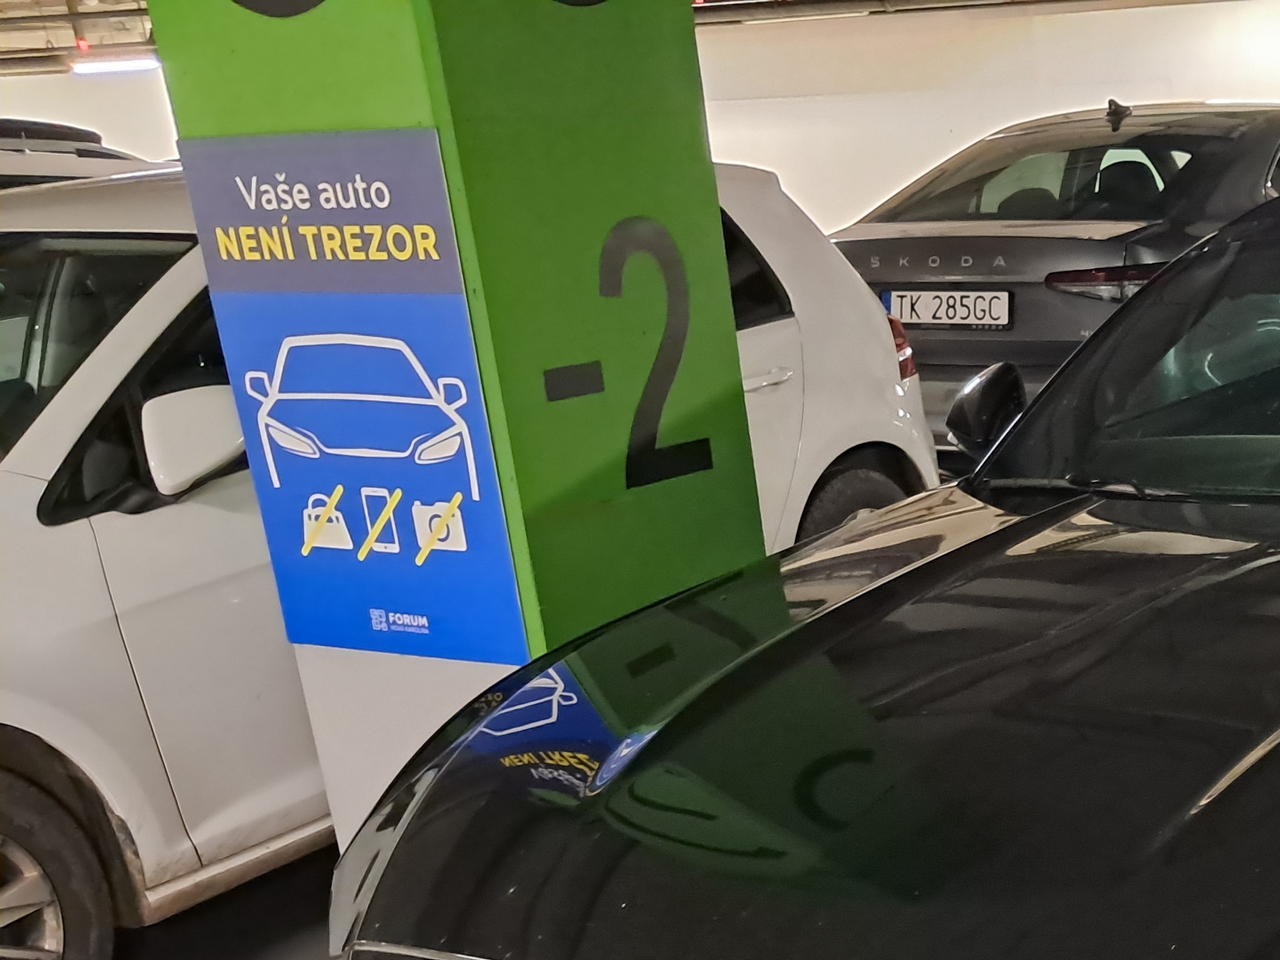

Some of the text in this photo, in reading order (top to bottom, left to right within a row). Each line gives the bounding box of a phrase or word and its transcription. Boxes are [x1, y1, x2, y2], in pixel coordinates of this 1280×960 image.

[234, 172, 391, 210] Vaše auto
[215, 214, 440, 261] NENÍ TREZOR
[896, 294, 1002, 322] TK 285GC
[544, 216, 713, 490] -2
[388, 612, 429, 628] FORUM
